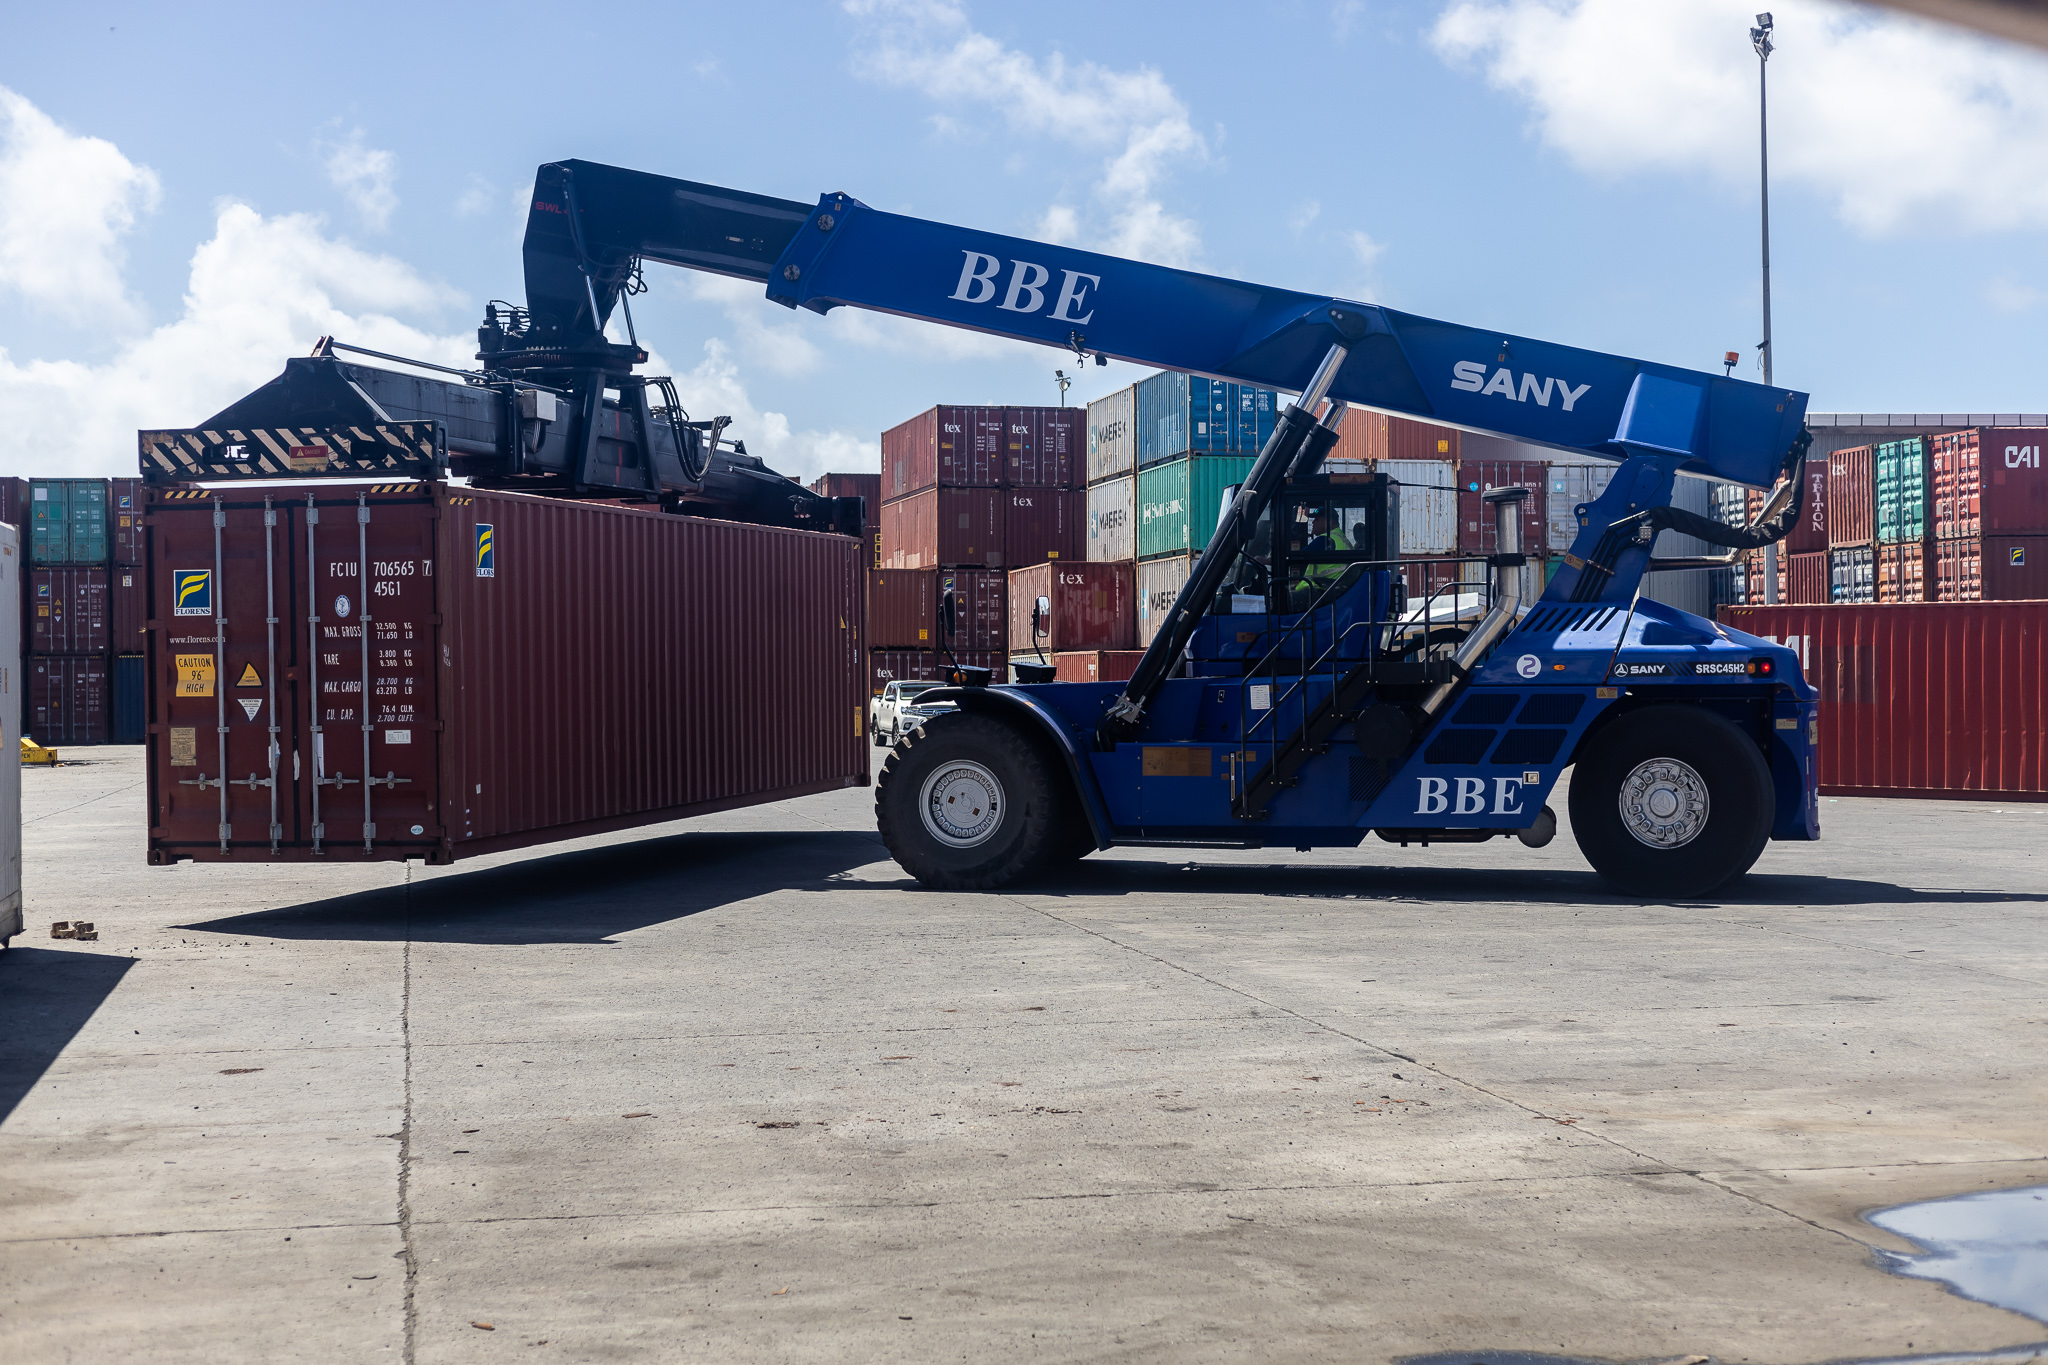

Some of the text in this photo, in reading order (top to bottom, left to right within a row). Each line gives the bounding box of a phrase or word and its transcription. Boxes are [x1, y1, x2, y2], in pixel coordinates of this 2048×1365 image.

[535, 201, 562, 214] SWL
[947, 249, 1101, 326] BBE
[1451, 360, 1592, 412] SANY
[944, 422, 961, 433] tex
[1011, 423, 1028, 434] tex
[2005, 446, 2040, 468] CAI
[1013, 495, 1033, 507] tex
[1812, 473, 1824, 532] TRITON
[330, 560, 431, 577] FCIU 706565 7
[1059, 571, 1084, 585] tex
[374, 581, 400, 596] 45G1
[324, 622, 413, 637] MAX. GROSS 32.500 KG
[376, 631, 413, 640] 71.650 LB
[178, 657, 212, 668] CAUTION
[323, 649, 412, 665] TARE 3.800 KG
[404, 659, 413, 667] LB
[876, 667, 894, 678] tex
[1522, 657, 1536, 676] 2
[1629, 663, 1745, 674] SANY SRSC45H2
[185, 683, 205, 693] HIGH
[324, 677, 414, 693] MAX. CARGO 28.700 KG
[376, 686, 413, 695] 63.270 LB
[326, 708, 336, 720] CU.
[340, 708, 354, 720] CAP.
[382, 704, 396, 713] 76.4
[377, 714, 395, 722] 2.700
[1413, 777, 1524, 815] BBE
